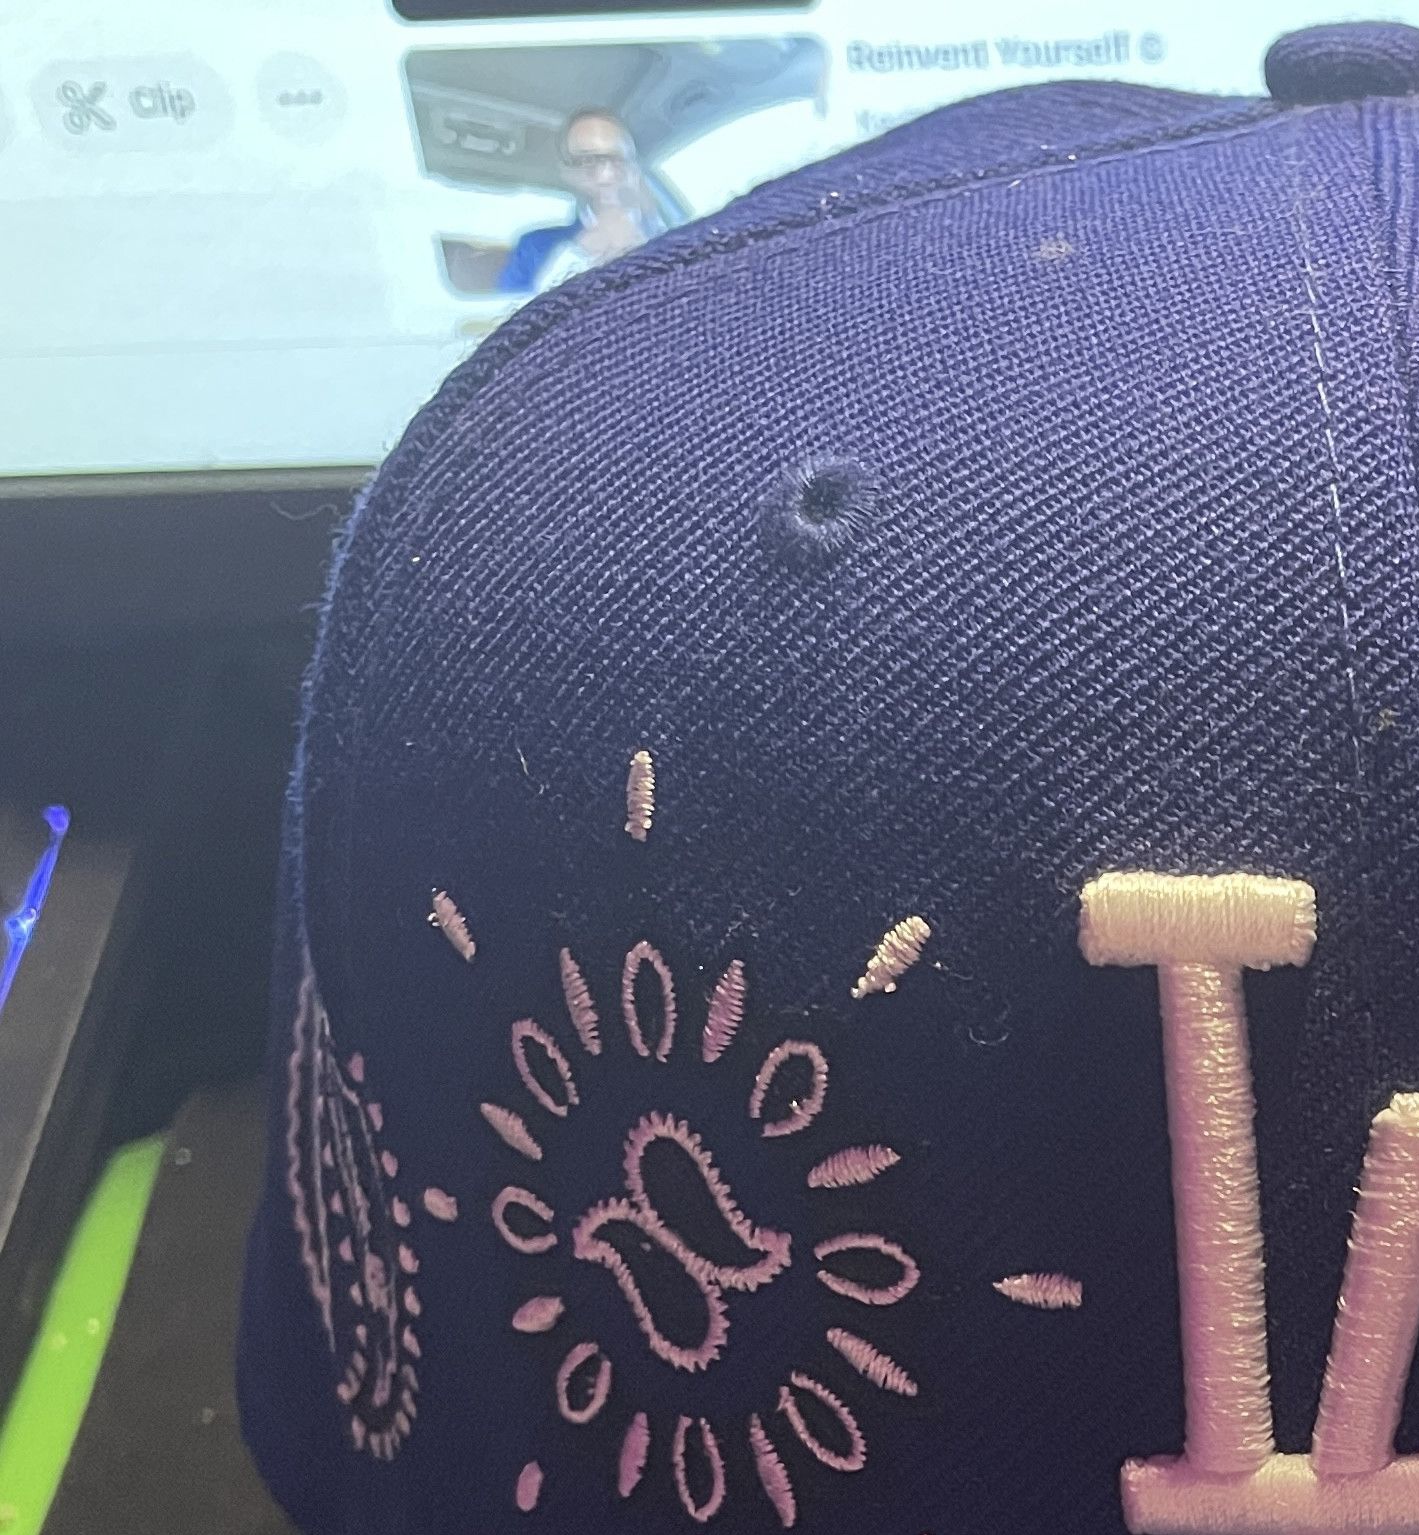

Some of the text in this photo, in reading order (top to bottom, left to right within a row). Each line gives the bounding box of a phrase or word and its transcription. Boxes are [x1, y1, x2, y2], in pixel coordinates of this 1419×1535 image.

[847, 31, 1130, 72] Reinvent Yourself
[128, 81, 196, 125] Clip
